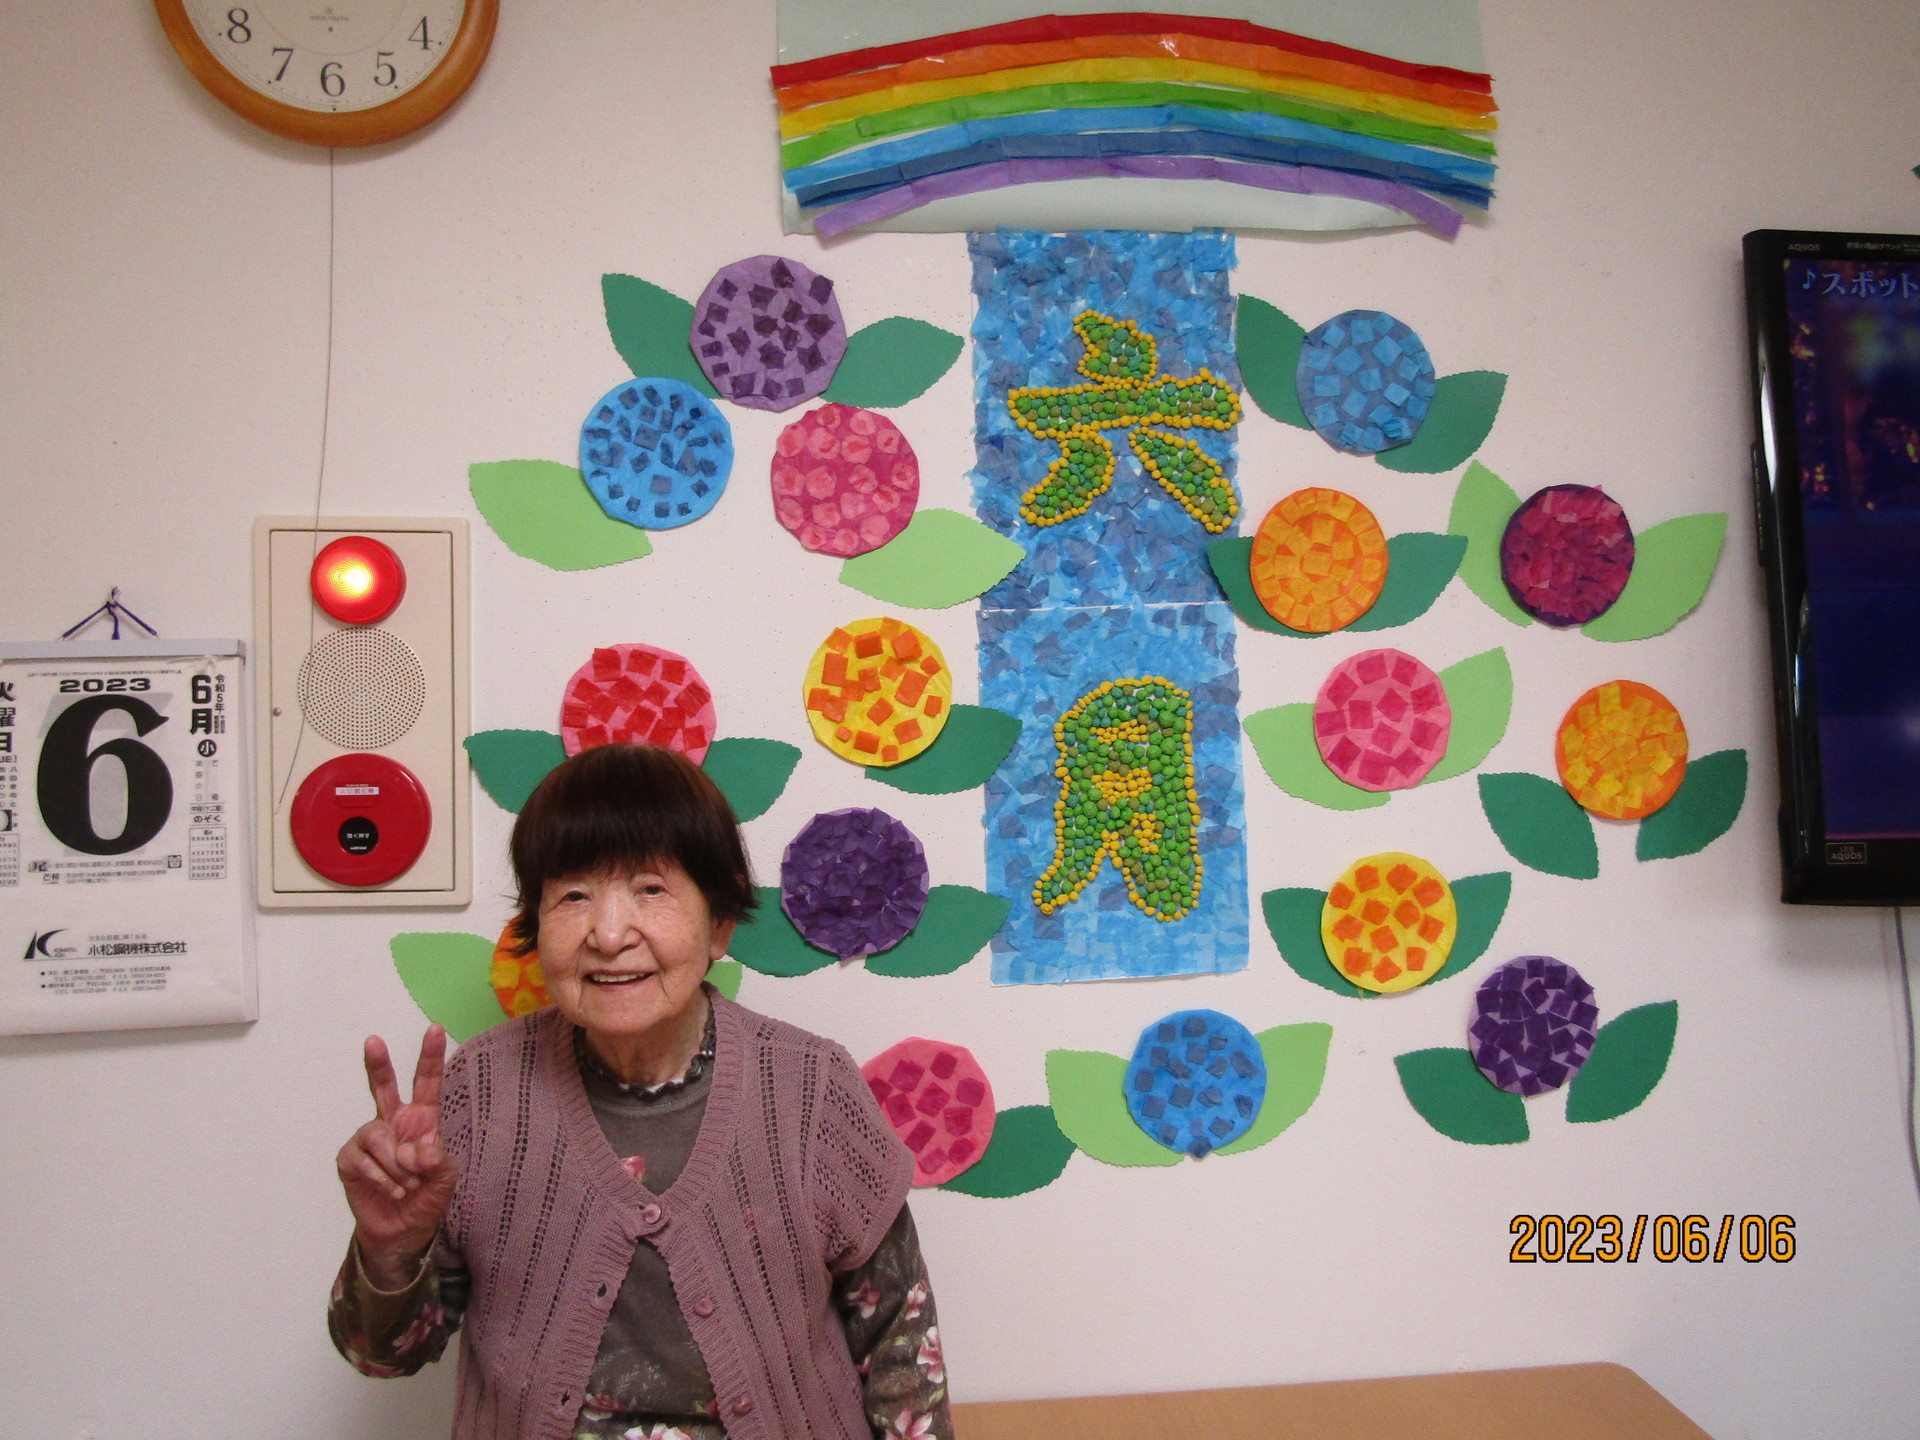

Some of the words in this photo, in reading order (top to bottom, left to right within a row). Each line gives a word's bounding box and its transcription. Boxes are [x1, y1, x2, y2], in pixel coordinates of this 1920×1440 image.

[227, 8, 252, 44] 8
[408, 16, 434, 50] 4
[271, 47, 294, 82] 7
[320, 62, 346, 97] 6
[374, 52, 397, 87] 5
[1788, 243, 1820, 252] AQUOS
[1822, 270, 1919, 299] スポット
[59, 678, 151, 693] 2023
[215, 673, 225, 712] 令和5年
[190, 674, 213, 735] 6月
[37, 694, 174, 856] 6
[194, 814, 221, 824] のぞく
[1832, 852, 1862, 860] AQUOS
